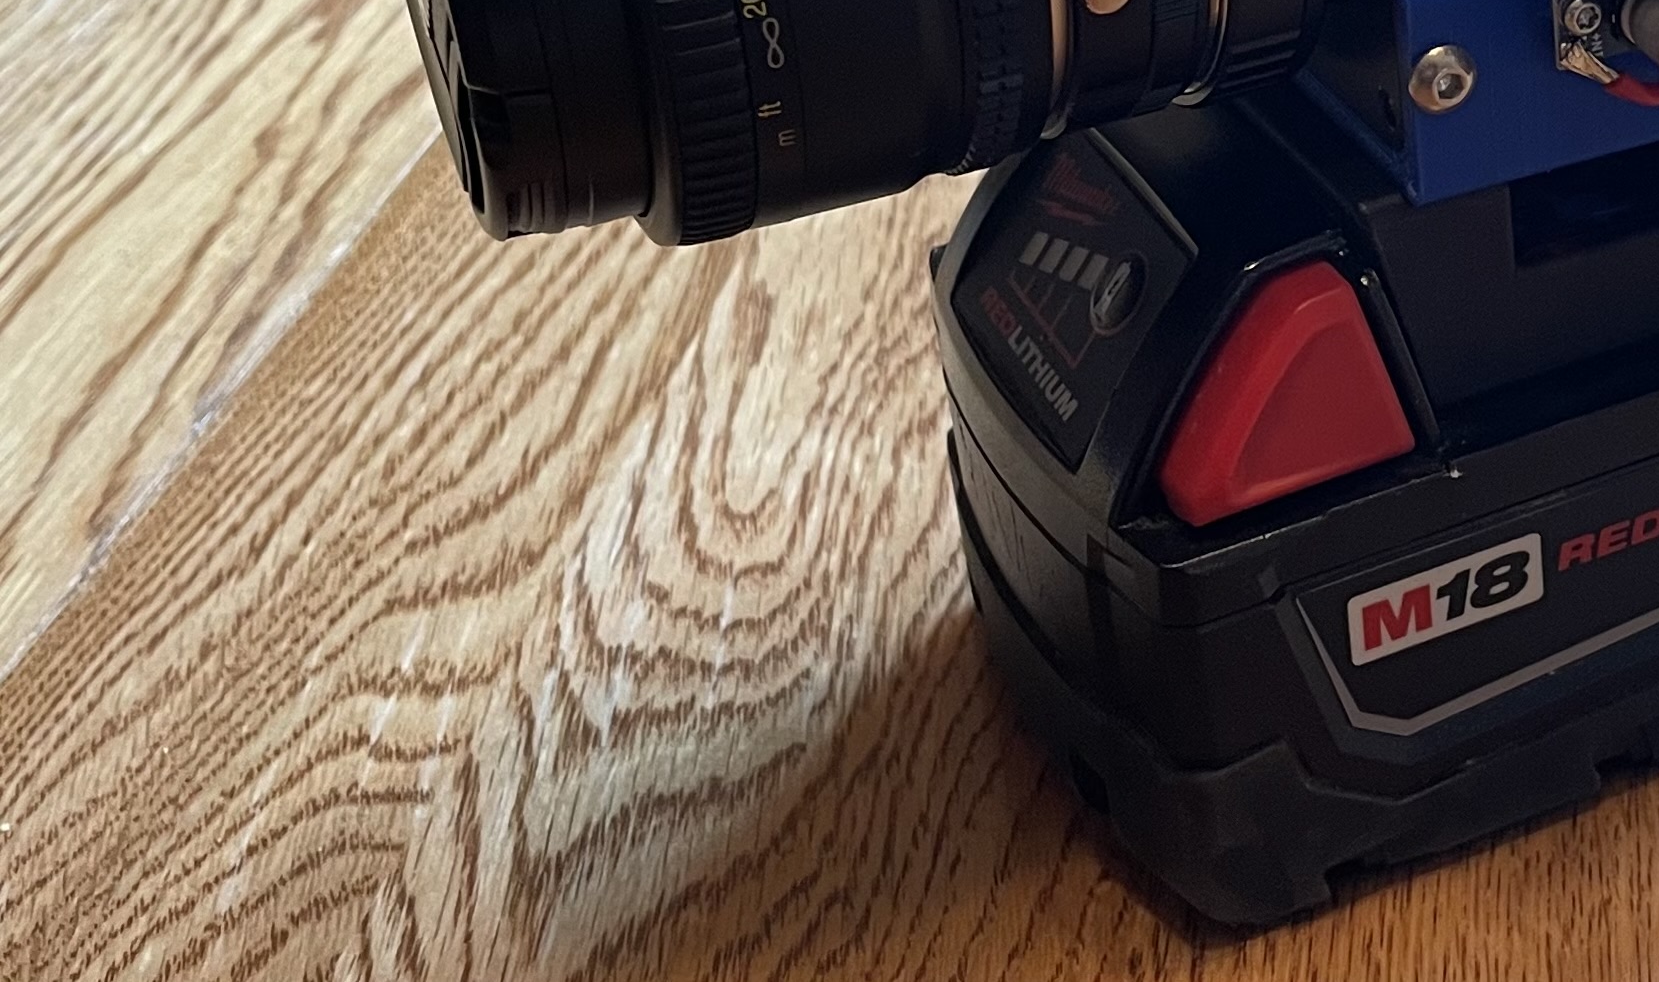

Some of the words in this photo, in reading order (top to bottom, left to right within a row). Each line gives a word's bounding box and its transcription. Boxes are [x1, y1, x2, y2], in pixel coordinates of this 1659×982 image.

[757, 100, 783, 118] ft
[979, 284, 1079, 423] REDLITHIUM
[1362, 549, 1531, 652] M18
